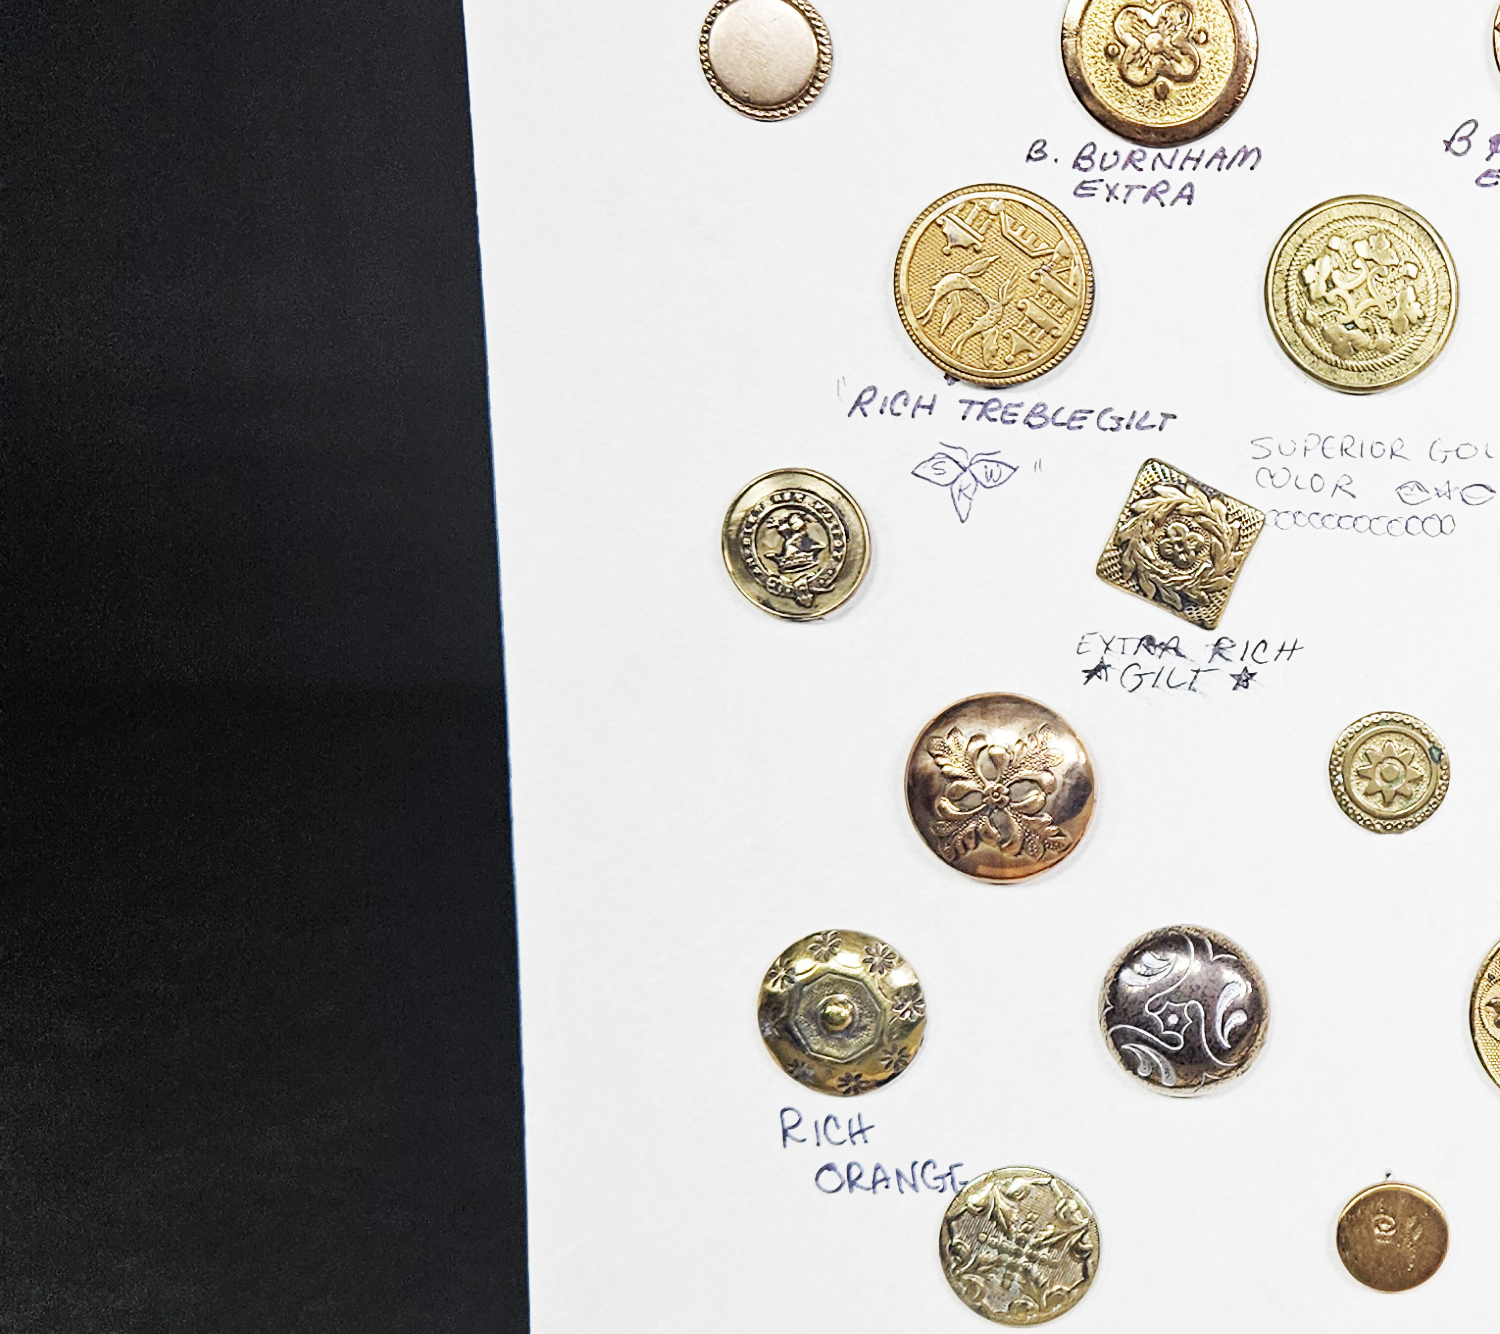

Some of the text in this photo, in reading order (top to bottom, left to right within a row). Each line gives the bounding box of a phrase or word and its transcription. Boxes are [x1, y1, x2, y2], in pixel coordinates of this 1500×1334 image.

[1071, 141, 1263, 173] BURNHAM
[1072, 178, 1196, 208] EXTRA
[1250, 433, 1411, 462] SUPERIOR
[1255, 466, 1357, 500] COLOR
[1076, 631, 1305, 665] EXTRA RICH
[1119, 662, 1221, 694] GILT
[779, 1106, 876, 1149] RICH
[814, 1158, 970, 1195] ORANGE
